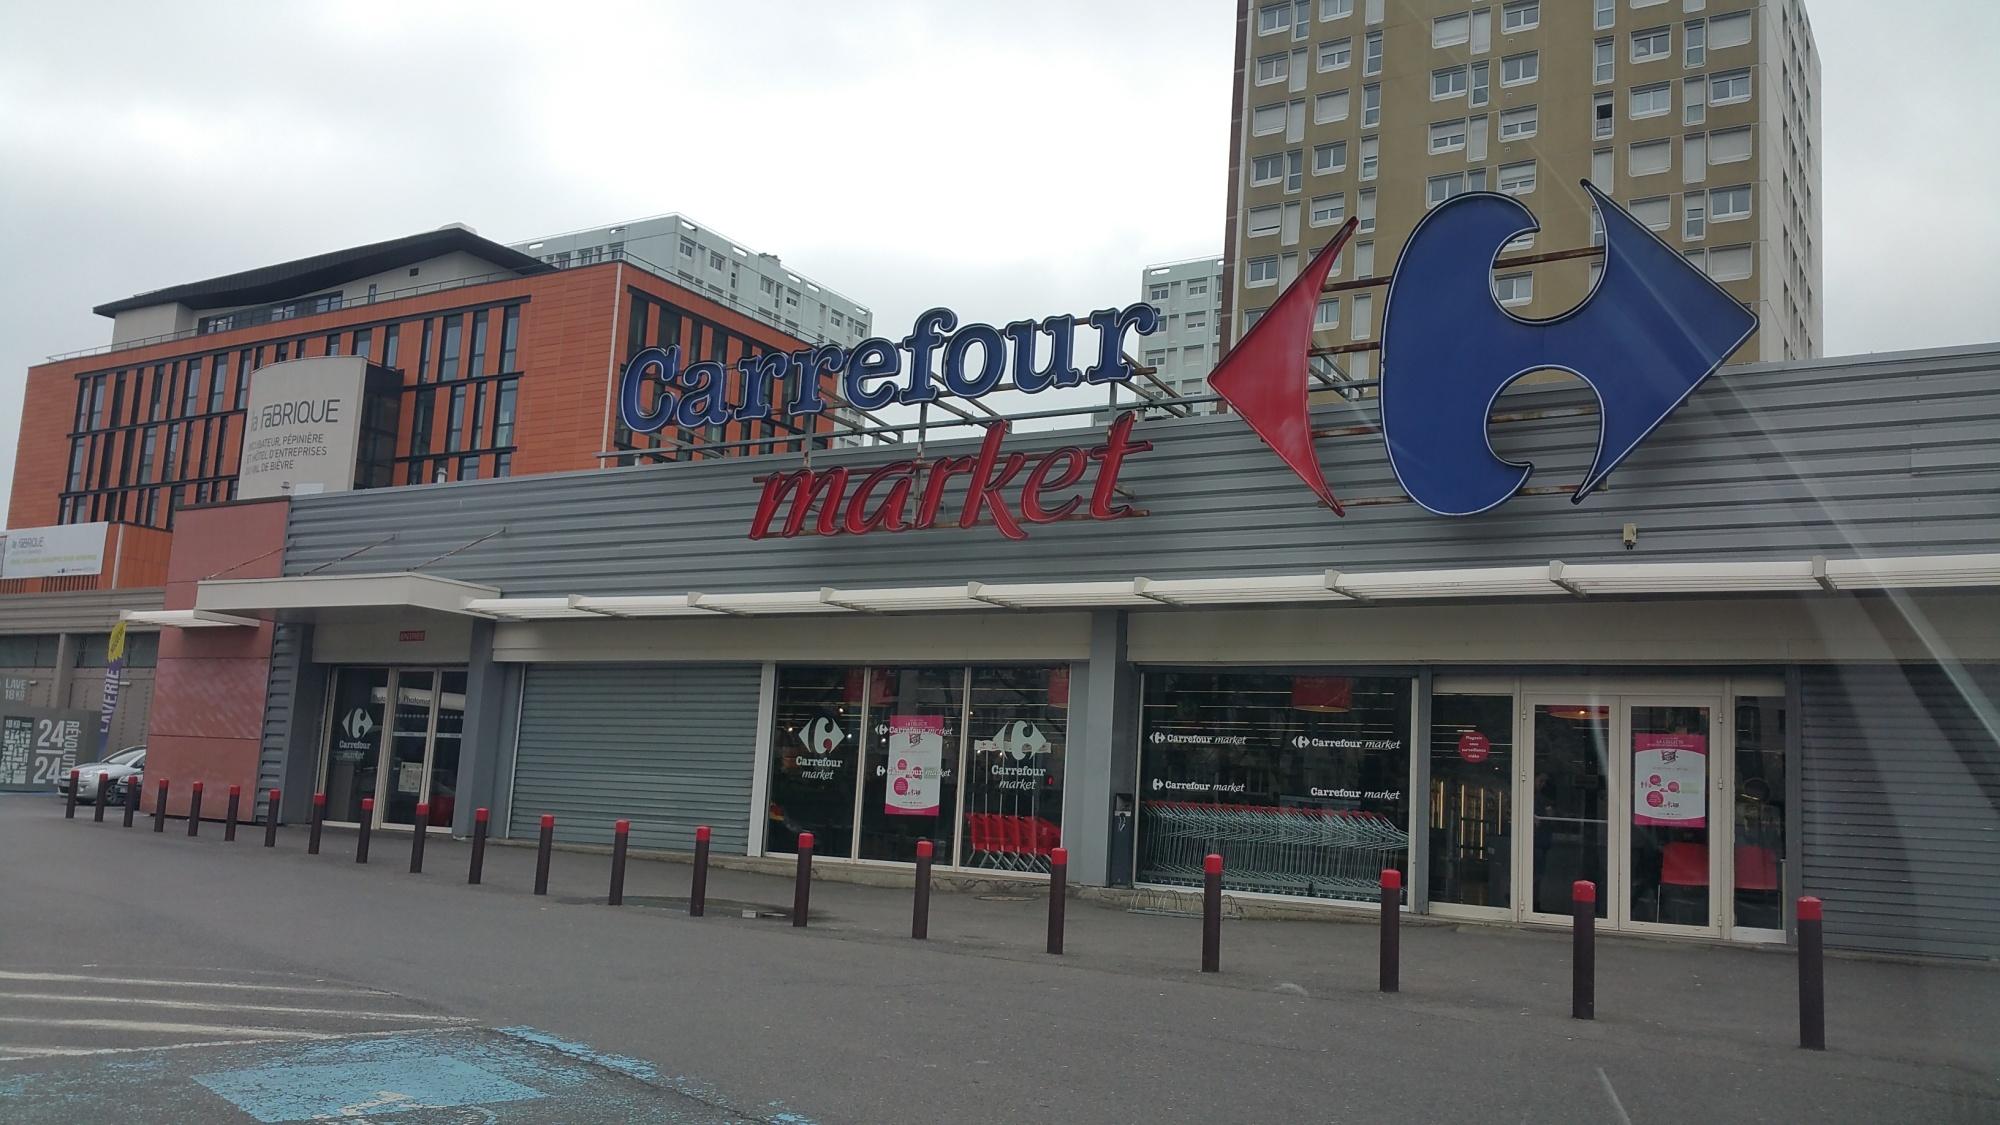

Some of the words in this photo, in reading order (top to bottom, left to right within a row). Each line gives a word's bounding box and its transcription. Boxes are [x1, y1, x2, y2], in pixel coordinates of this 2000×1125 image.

[620, 301, 1160, 434] Carrefour
[269, 446, 327, 459] D'ENTREPRISES
[748, 410, 1155, 541] market
[5, 678, 27, 690] LAVE
[5, 689, 15, 700] 18
[100, 668, 120, 733] LAVERIE
[38, 719, 65, 748] 24
[889, 726, 925, 735] Carrefour
[339, 740, 372, 750] Carrefour
[1167, 734, 1213, 744] Carrefour
[1214, 735, 1247, 745] market
[1311, 738, 1362, 748] Carrefour
[1364, 739, 1401, 750] market
[795, 756, 843, 768] Carrefour
[33, 756, 61, 784] 24
[801, 769, 835, 780] market
[991, 764, 1046, 777] Carrefour
[998, 778, 1037, 791] market
[1165, 780, 1211, 791] Carrefour
[1212, 782, 1245, 793] market
[1310, 787, 1362, 798] Carrefour
[1364, 789, 1400, 800] market
